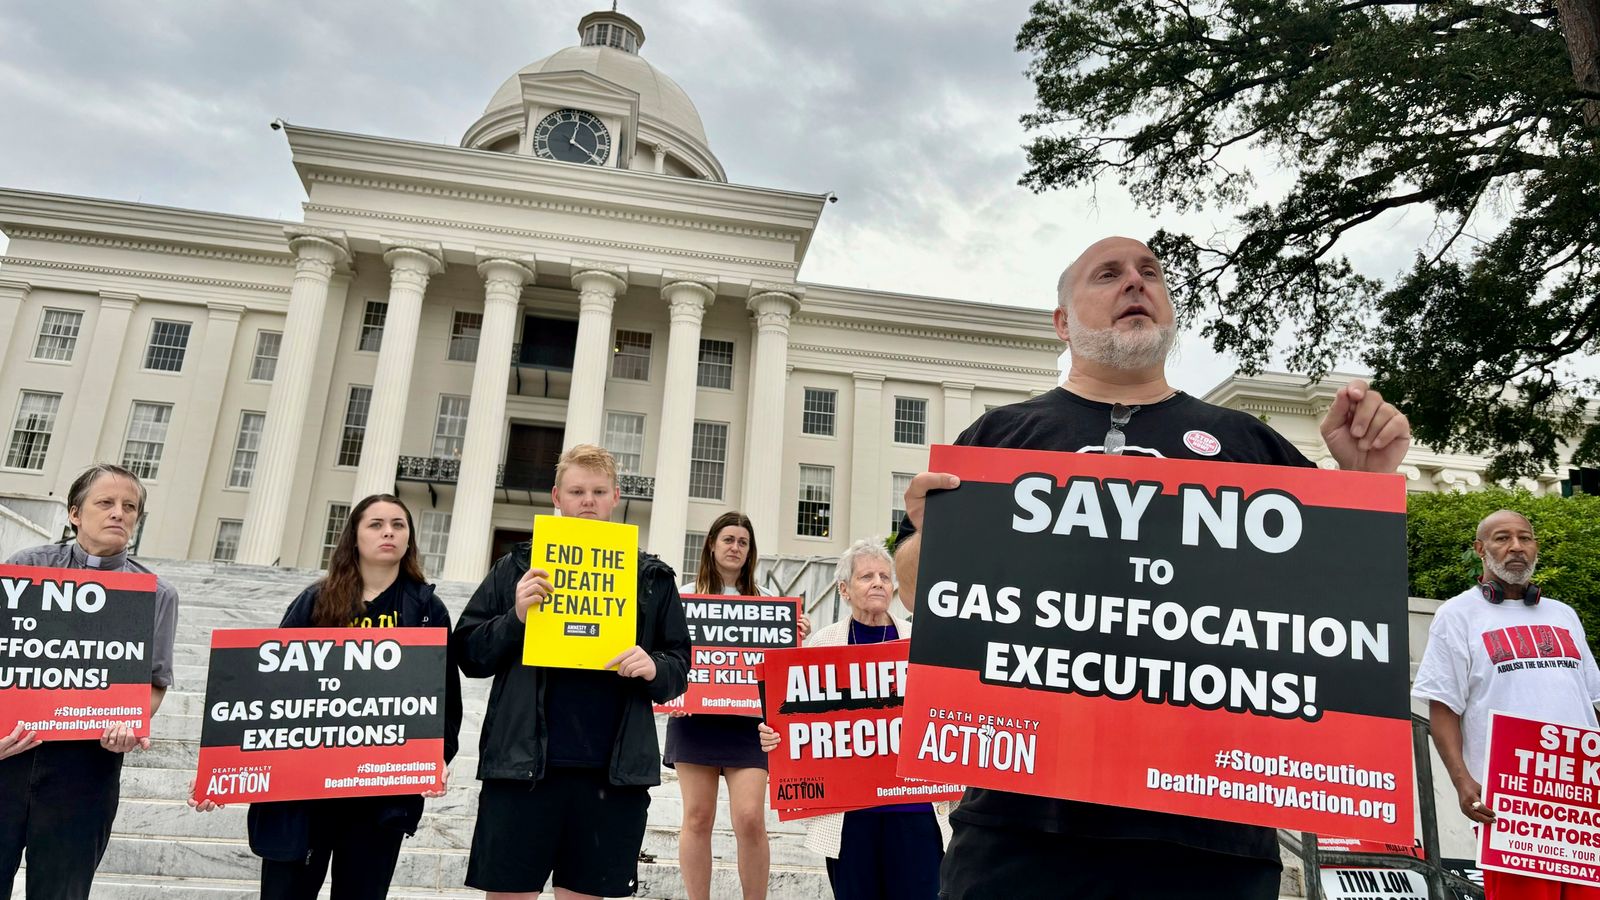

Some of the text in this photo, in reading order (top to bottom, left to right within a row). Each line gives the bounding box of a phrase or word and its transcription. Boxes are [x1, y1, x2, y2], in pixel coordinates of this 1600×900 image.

[1012, 476, 1303, 554] SAY NO
[546, 543, 625, 570] END THE
[554, 568, 614, 592] DEATH
[1129, 557, 1174, 586] TO
[41, 581, 107, 613] NO
[539, 592, 626, 617] PENALTY
[12, 616, 37, 631] TO
[682, 602, 791, 621] MEMBER
[927, 581, 1390, 663] GAS SUFFOCATION
[702, 625, 793, 644] VICTIMS
[0, 638, 144, 660] FFOCATION
[258, 640, 402, 672] SAY NO
[696, 651, 738, 665] NOT
[0, 667, 108, 688] UTIONS!
[716, 670, 758, 684] KILL
[1498, 662, 1524, 673] ABOLISH
[1525, 660, 1536, 669] THE
[1537, 660, 1556, 669] DEATH
[318, 677, 341, 691] TO
[786, 664, 842, 702] ALL
[984, 642, 1318, 717] EXECUTIONS!
[54, 706, 142, 718] #StopExecutions
[211, 696, 437, 721] GAS SUFFOCATION
[702, 697, 761, 709] DeathPenaltyA
[929, 708, 1040, 731] DEATH PENALTY
[242, 724, 406, 750] EXECUTIONS!
[788, 717, 903, 760] PRECI
[917, 722, 1037, 775] ACTION
[1540, 725, 1600, 757] STO
[239, 765, 272, 773] PENALTY
[357, 761, 436, 774] #StopExecutions
[1214, 749, 1396, 791] #StopExecutions
[1515, 749, 1576, 782] THE
[206, 771, 270, 795] ACTION
[324, 775, 436, 789] DeathPenaltyAction.org
[777, 782, 825, 800] ACTION
[876, 783, 967, 797] DeathPenaltyAction.o
[1499, 773, 1593, 803] THE DANGER
[1146, 768, 1397, 824] DeathPenaltyAction.org
[1498, 797, 1600, 828] DEMOCRAC
[1496, 817, 1600, 848] DICTATORS
[1509, 839, 1595, 862] YOUR VOICE. YOUR
[1501, 854, 1599, 881] VOTE TUESDAY,
[1336, 870, 1414, 893] NOT KILL!
